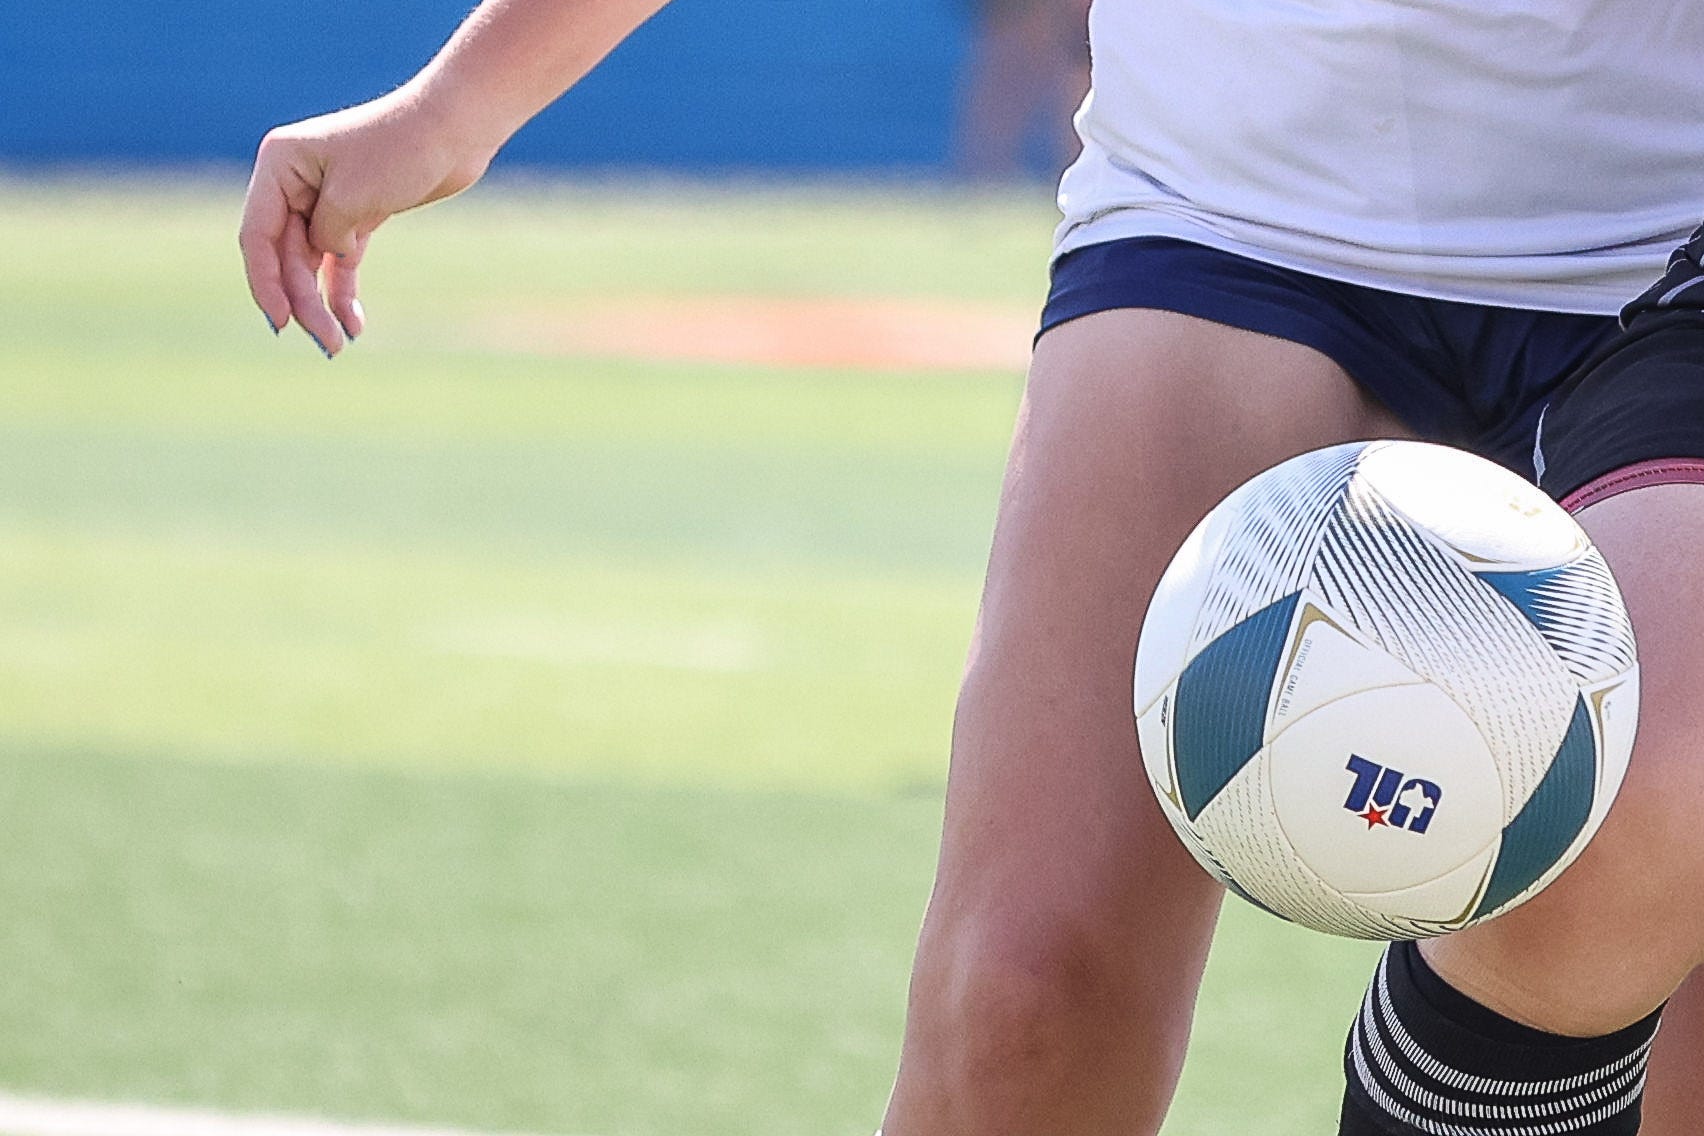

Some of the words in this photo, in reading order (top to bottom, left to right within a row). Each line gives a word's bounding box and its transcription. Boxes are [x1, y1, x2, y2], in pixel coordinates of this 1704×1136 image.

[1294, 638, 1313, 672] OFFICIAL
[1285, 674, 1298, 696] GAME
[1278, 698, 1291, 717] BALL
[1343, 753, 1442, 834] UIL
